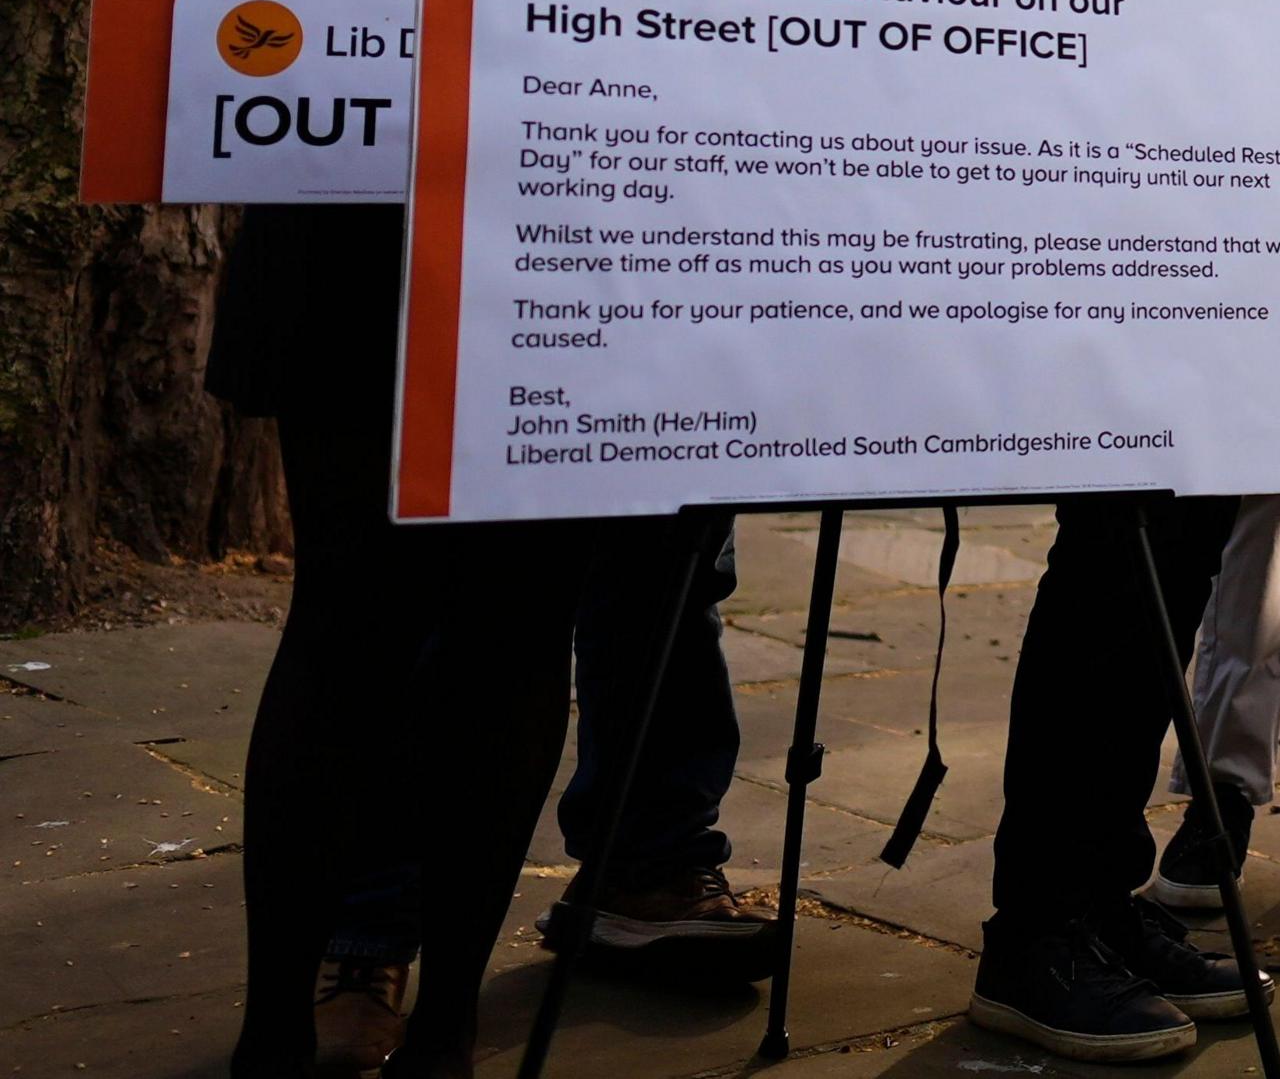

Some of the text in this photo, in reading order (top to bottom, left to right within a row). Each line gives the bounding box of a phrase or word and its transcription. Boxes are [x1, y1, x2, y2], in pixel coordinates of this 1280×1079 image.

[326, 26, 385, 58] Lib
[525, 2, 1088, 70] High Street [OUT OF OFFICE]
[522, 74, 659, 102] Dear Anne,
[213, 95, 392, 158] [OUT
[517, 176, 675, 205] working day.
[510, 327, 609, 349] caused.
[508, 384, 572, 409] Best,
[506, 409, 758, 439] John Smith (He/Him)
[505, 428, 1176, 466] Liberal Democrat Controlled South Cambridgeshire Council
